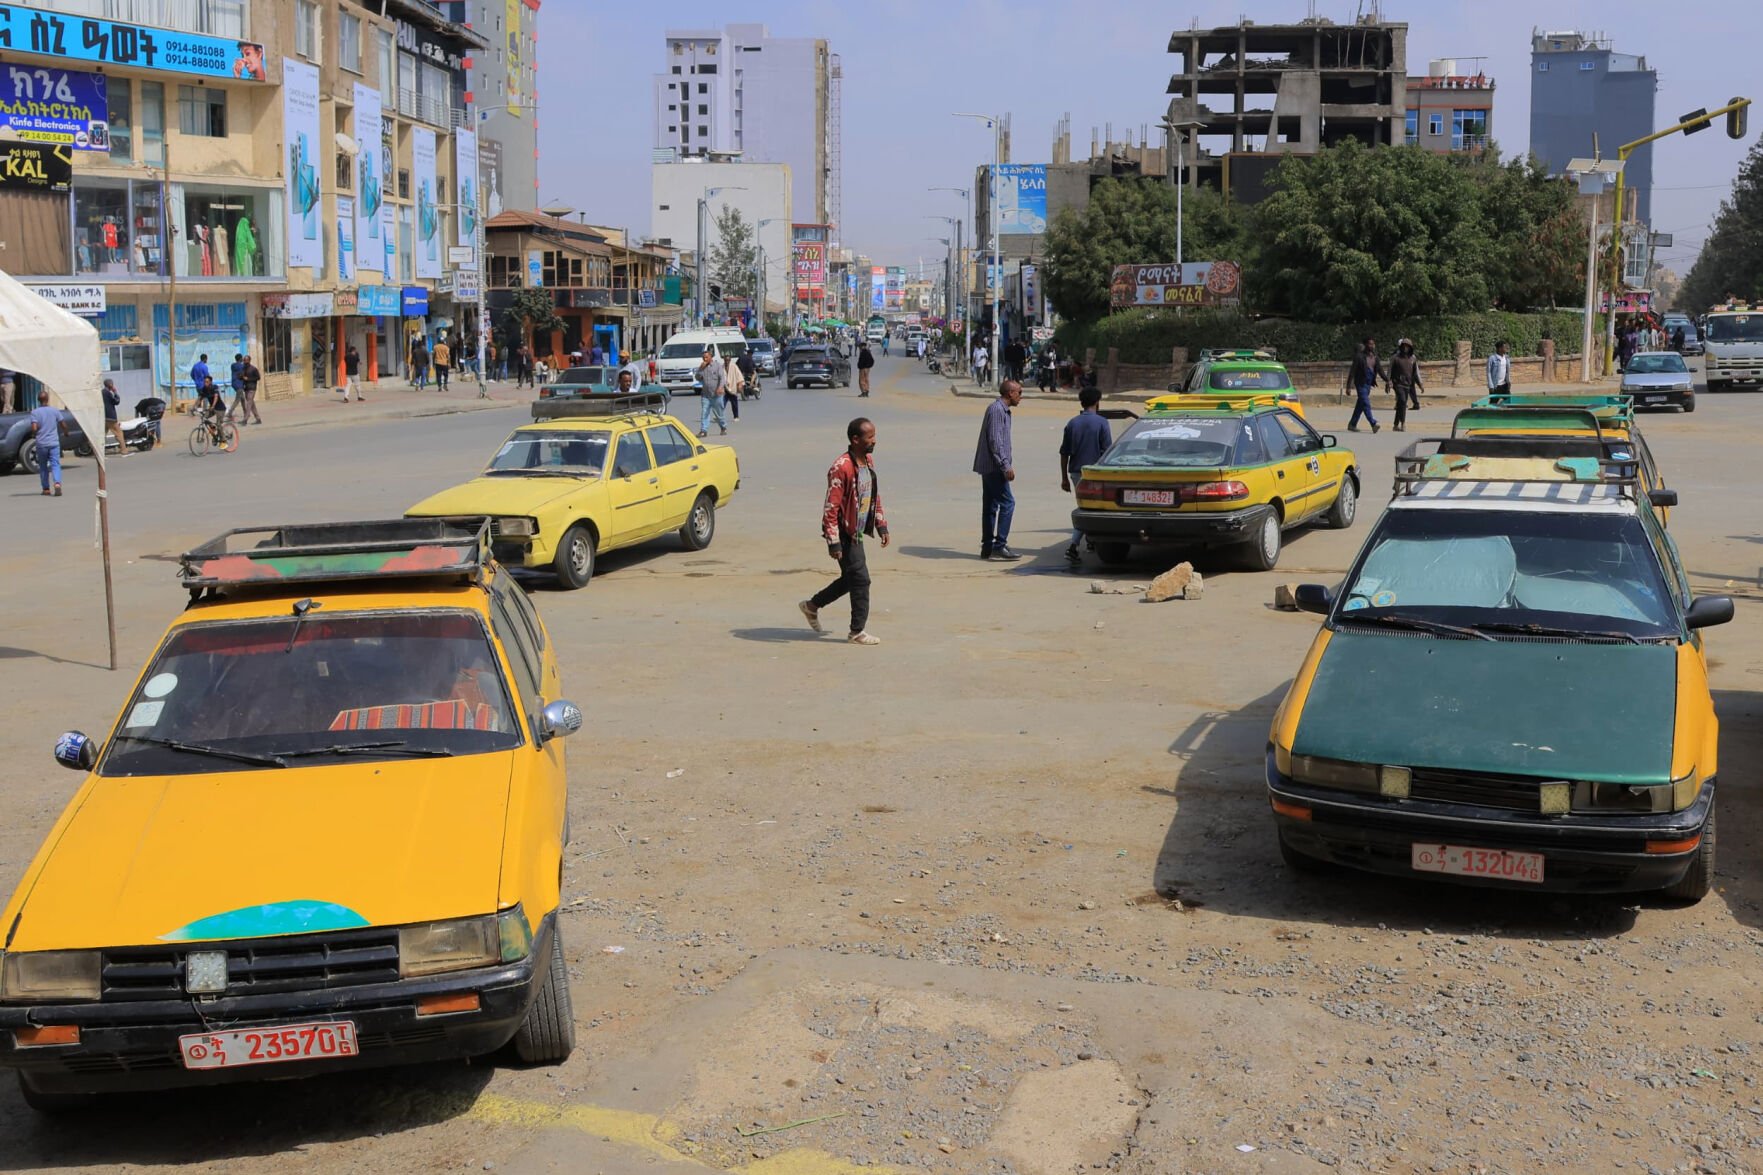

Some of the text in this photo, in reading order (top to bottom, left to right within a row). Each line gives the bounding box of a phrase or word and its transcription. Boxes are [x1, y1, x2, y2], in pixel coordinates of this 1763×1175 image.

[30, 12, 66, 55] ስኒ
[165, 40, 225, 58] 0914-881088
[165, 53, 226, 70] 0914-888008
[9, 66, 76, 103] ክንፈ
[9, 116, 81, 131] Kinfe Electronics
[6, 158, 48, 179] KAL
[1462, 850, 1528, 878] 13204
[245, 1028, 336, 1060] 23570
